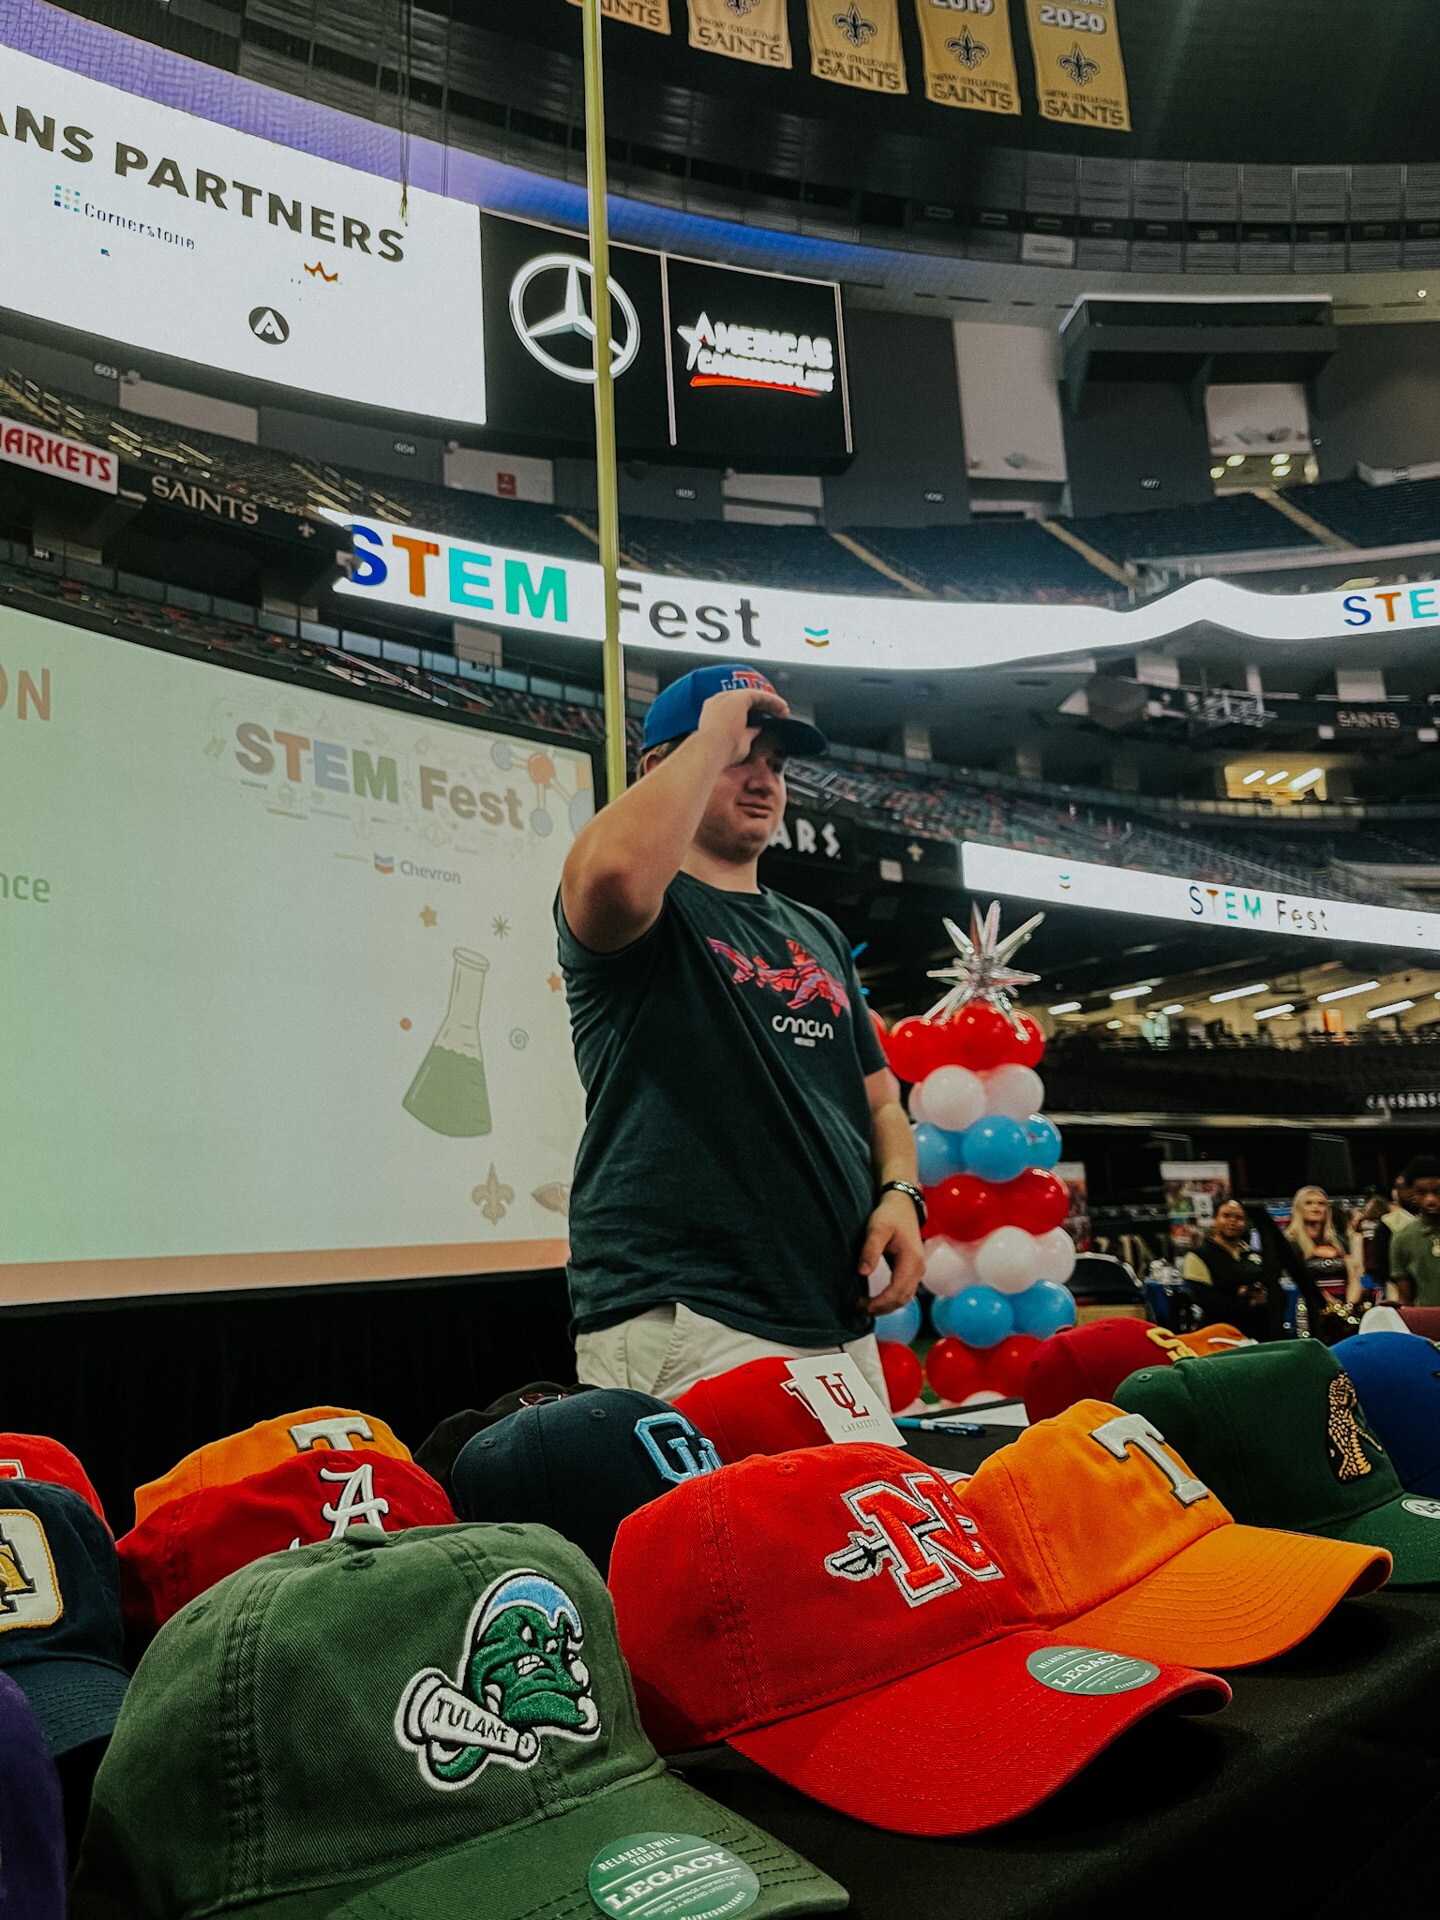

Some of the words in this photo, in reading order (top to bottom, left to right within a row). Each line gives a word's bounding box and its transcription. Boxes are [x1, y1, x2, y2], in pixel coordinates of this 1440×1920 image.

[1040, 4, 1106, 34] 2020
[698, 27, 784, 62] SAINTS
[818, 58, 900, 90] SAINTS
[932, 83, 1013, 110] SAINTS
[1044, 100, 1125, 126] SAINTS
[114, 142, 405, 262] PARTNERS
[85, 202, 195, 250] Cornerstone
[151, 474, 259, 525] SAINTS
[351, 525, 568, 623] STEM
[1343, 588, 1439, 626] STE
[1337, 711, 1400, 729] SAINTS
[235, 722, 399, 804] STEM
[419, 764, 525, 830] Fest
[400, 860, 461, 884] Chevron
[1189, 885, 1262, 920] STEM
[1276, 899, 1328, 931] Fest
[1089, 1413, 1209, 1509] T
[303, 1464, 389, 1545] A
[1052, 1654, 1126, 1688] LEGACY
[433, 1697, 509, 1743] TULANE
[597, 1846, 647, 1871] RELAXED
[646, 1836, 681, 1851] TWILL
[629, 1849, 667, 1867] YOUTH
[605, 1852, 730, 1909] LEGACY
